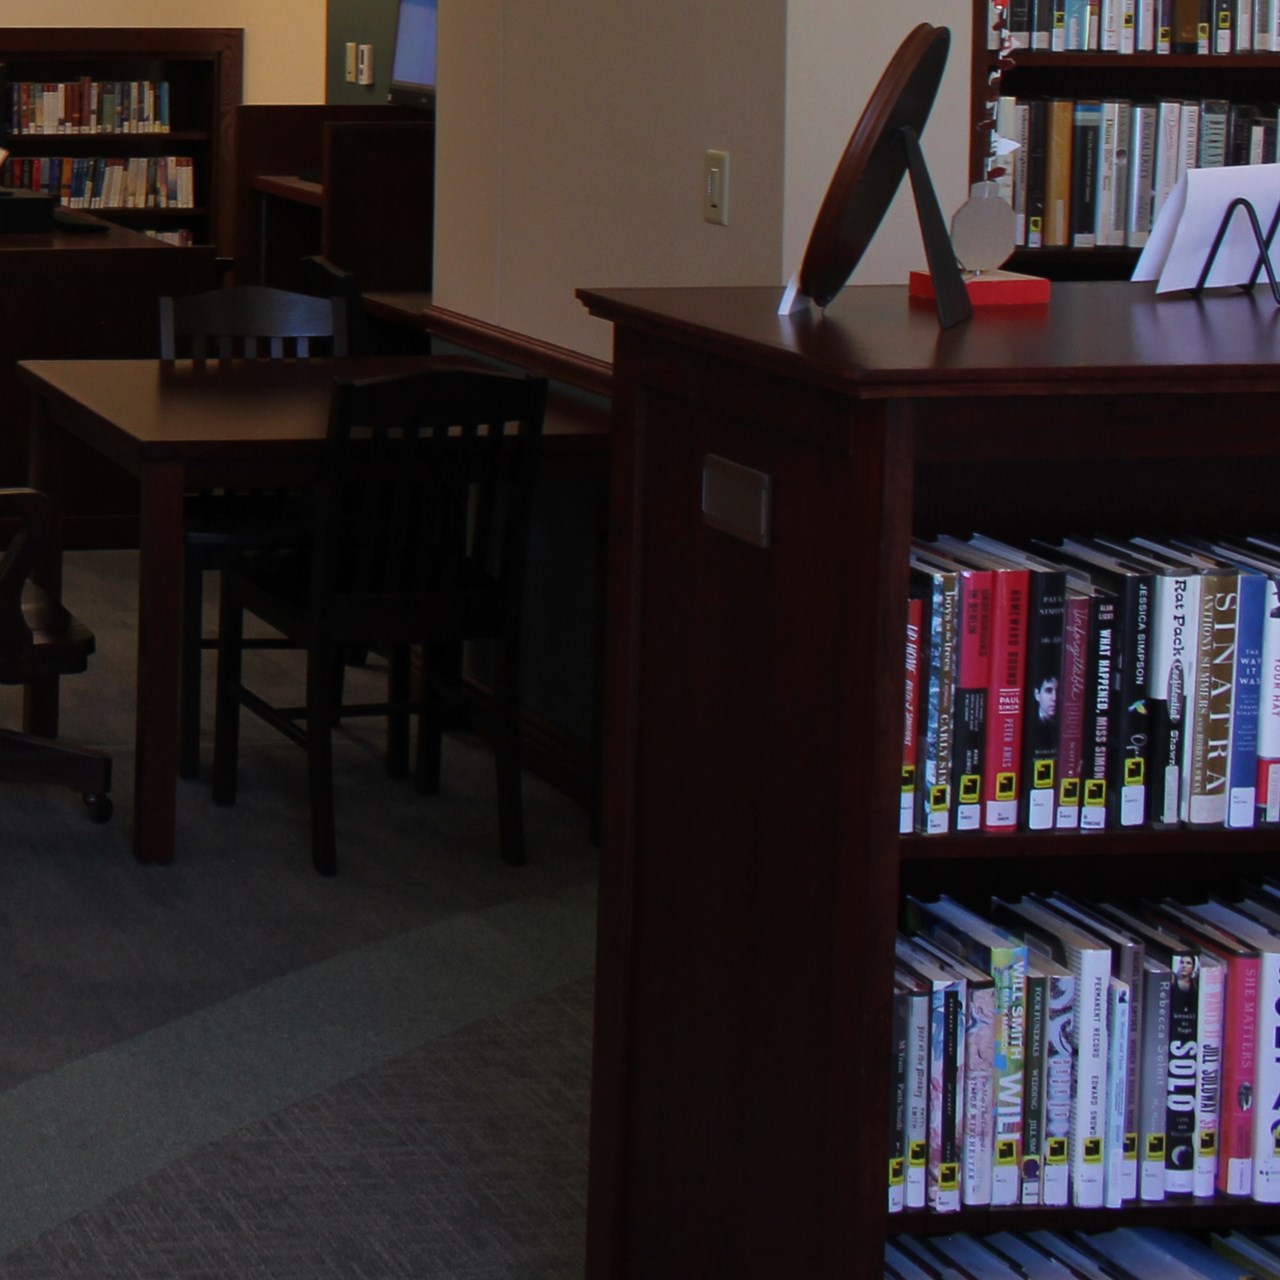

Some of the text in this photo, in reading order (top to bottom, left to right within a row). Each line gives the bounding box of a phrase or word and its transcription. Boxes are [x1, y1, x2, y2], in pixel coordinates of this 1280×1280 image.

[1104, 118, 1114, 144] Diana
[1141, 121, 1152, 180] ROYAL DUTY
[904, 624, 918, 675] UP HOME
[942, 591, 955, 671] boys trees
[1007, 589, 1020, 685] HOMEWARD BOUND
[1136, 584, 1148, 685] JESSICA SIMPSON
[1169, 580, 1186, 721] Rat Pack Confidential
[1200, 594, 1214, 653] ANTHONY
[1066, 608, 1088, 700] Unforgettable
[1000, 696, 1020, 704] PAUL
[1095, 629, 1112, 742] WHAT HAPPENED, MISS
[1198, 656, 1211, 714] SUMMERS
[1206, 592, 1237, 793] SINATRA
[1272, 694, 1280, 716] HAT
[938, 714, 950, 758] CARLY
[1002, 718, 1014, 768] PETER AMES
[1168, 730, 1178, 767] Shawn
[1193, 769, 1202, 794] SWAN
[1206, 968, 1222, 987] SHE
[1000, 988, 1010, 1055] MARK MANSON
[1010, 962, 1024, 1060] WILL SMITH
[1032, 986, 1042, 1056] FOUR FUNERALS
[1092, 977, 1102, 1058] PERMANENT RECORD
[1157, 981, 1170, 1038] Rebecca
[1204, 991, 1221, 1026] WANTS
[1242, 968, 1256, 1068] SHE MATTERS
[898, 1040, 906, 1072] M Train
[914, 1026, 926, 1098] Year of the Monkey
[1156, 1046, 1167, 1086] Solnit
[1166, 1040, 1198, 1112] SOLO
[1201, 1044, 1219, 1114] JILL SOLOWAY
[896, 1104, 904, 1130] Smith
[1030, 1068, 1038, 1109] WEDDING
[1090, 1075, 1099, 1106] EDWARD
[968, 1114, 976, 1180] WINCHESTER
